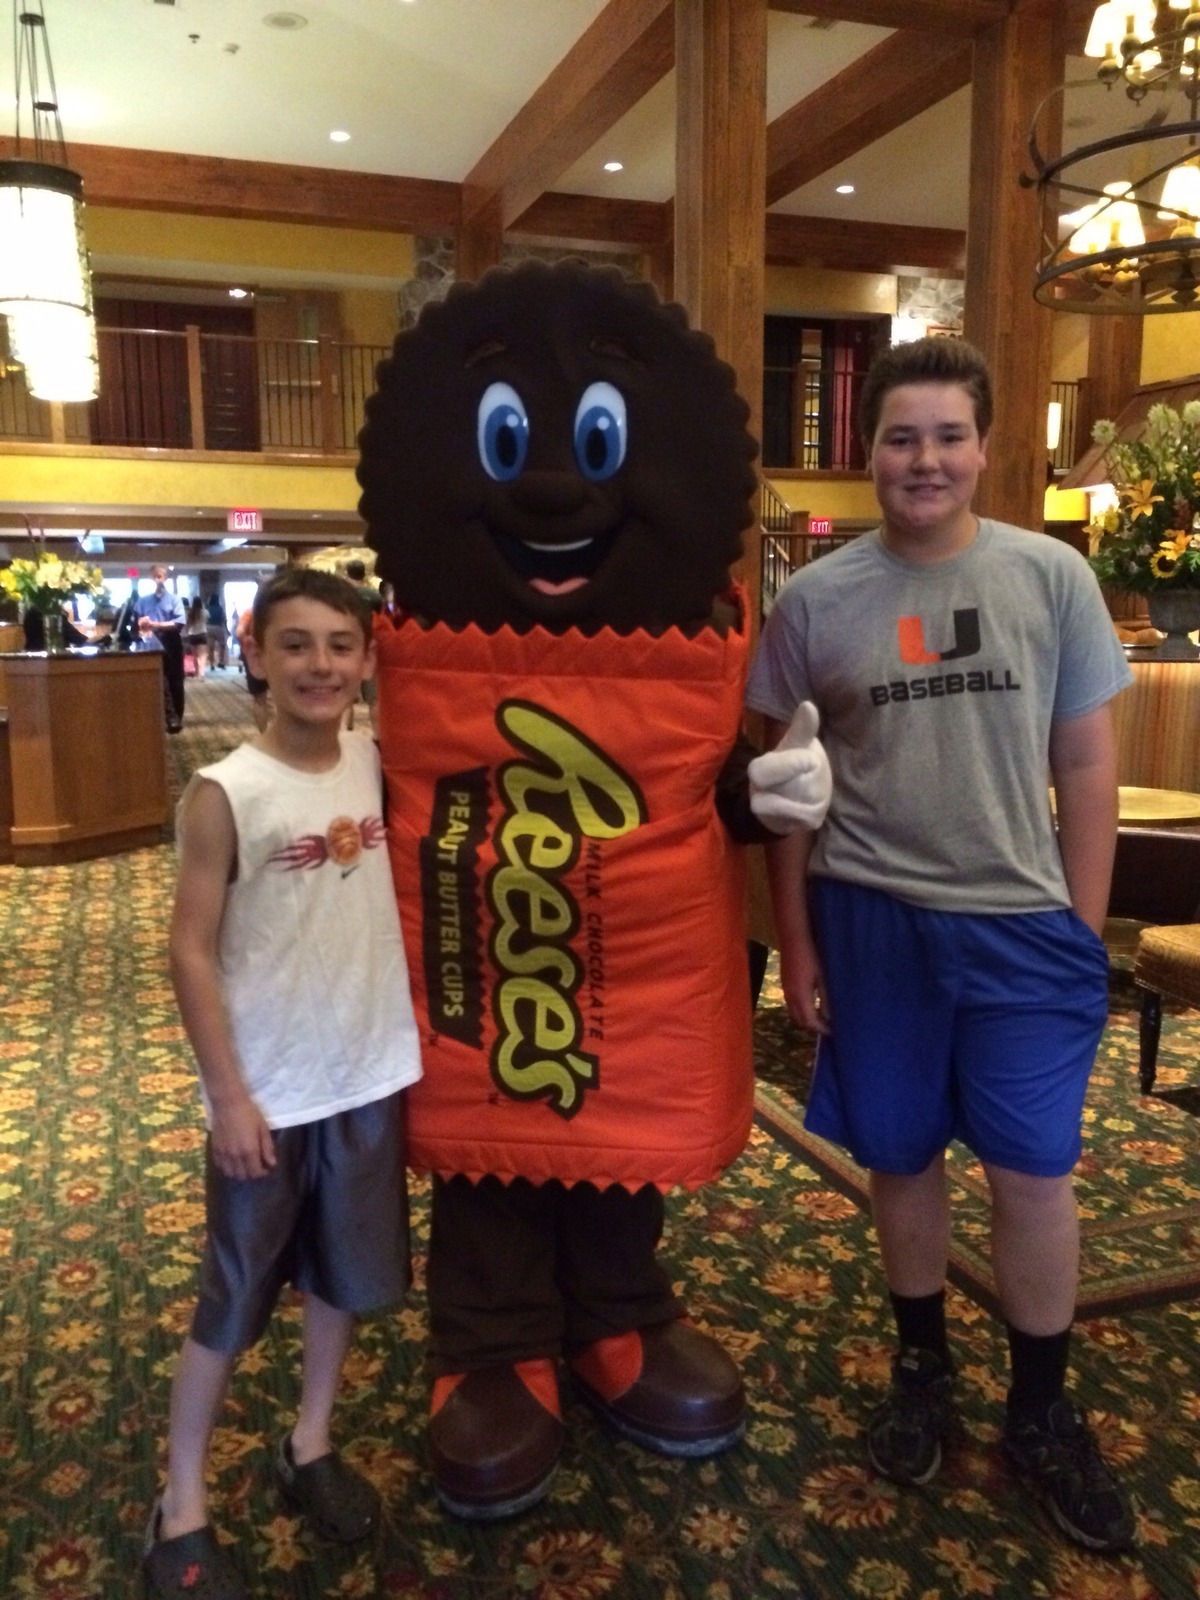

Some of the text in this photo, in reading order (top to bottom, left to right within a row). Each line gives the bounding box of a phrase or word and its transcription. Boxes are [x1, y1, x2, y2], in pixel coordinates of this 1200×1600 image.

[234, 511, 257, 530] EXIT
[811, 521, 829, 534] EXIT
[897, 608, 981, 665] U
[437, 870, 462, 954] BUTTER
[491, 702, 644, 1113] Reese's
[585, 842, 605, 1041] MILK CHOCOLATE
[440, 961, 465, 1018] CUPS
